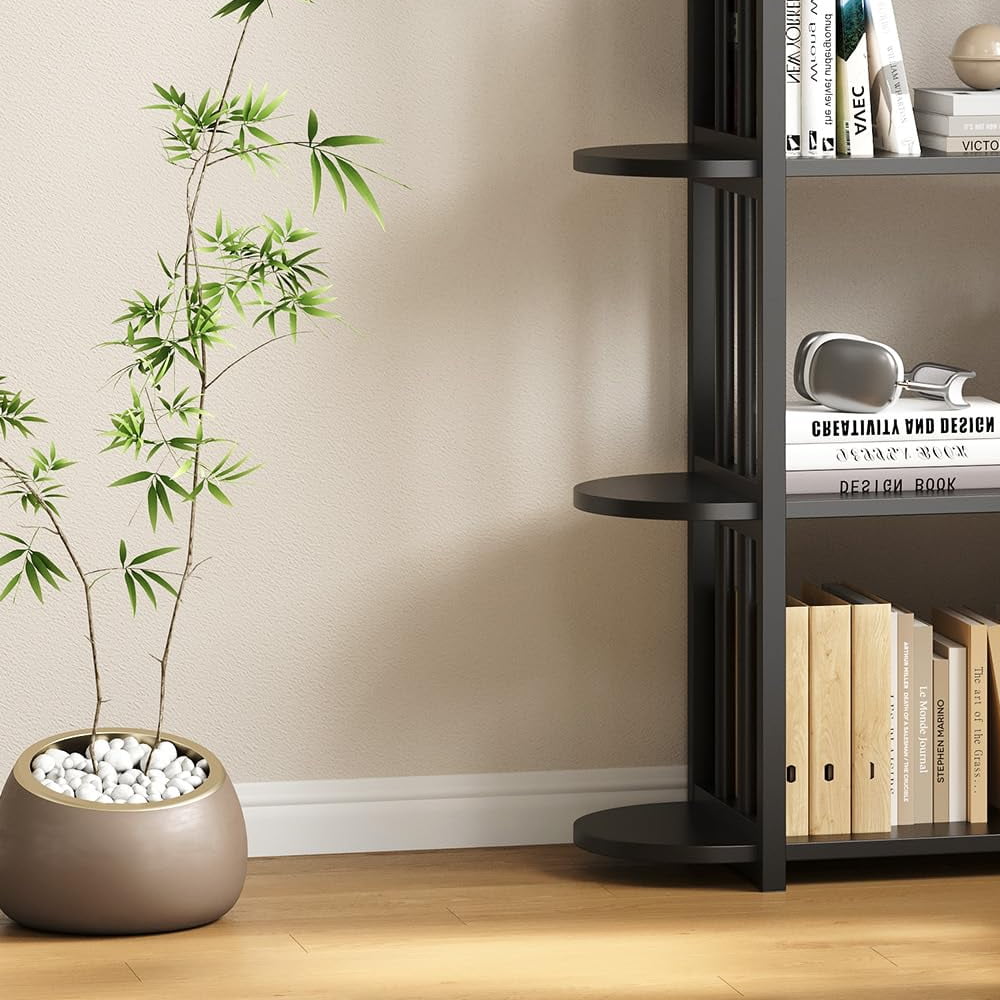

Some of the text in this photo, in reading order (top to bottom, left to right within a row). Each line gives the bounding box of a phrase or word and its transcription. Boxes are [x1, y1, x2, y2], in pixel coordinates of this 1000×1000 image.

[887, 45, 908, 125] WILLIAM WHARTON
[974, 666, 984, 683] The
[974, 688, 984, 704] art
[974, 710, 984, 722] of
[918, 686, 928, 773] Le Monde Journal
[974, 728, 984, 744] the
[936, 700, 944, 783] STEPHEN MARINO
